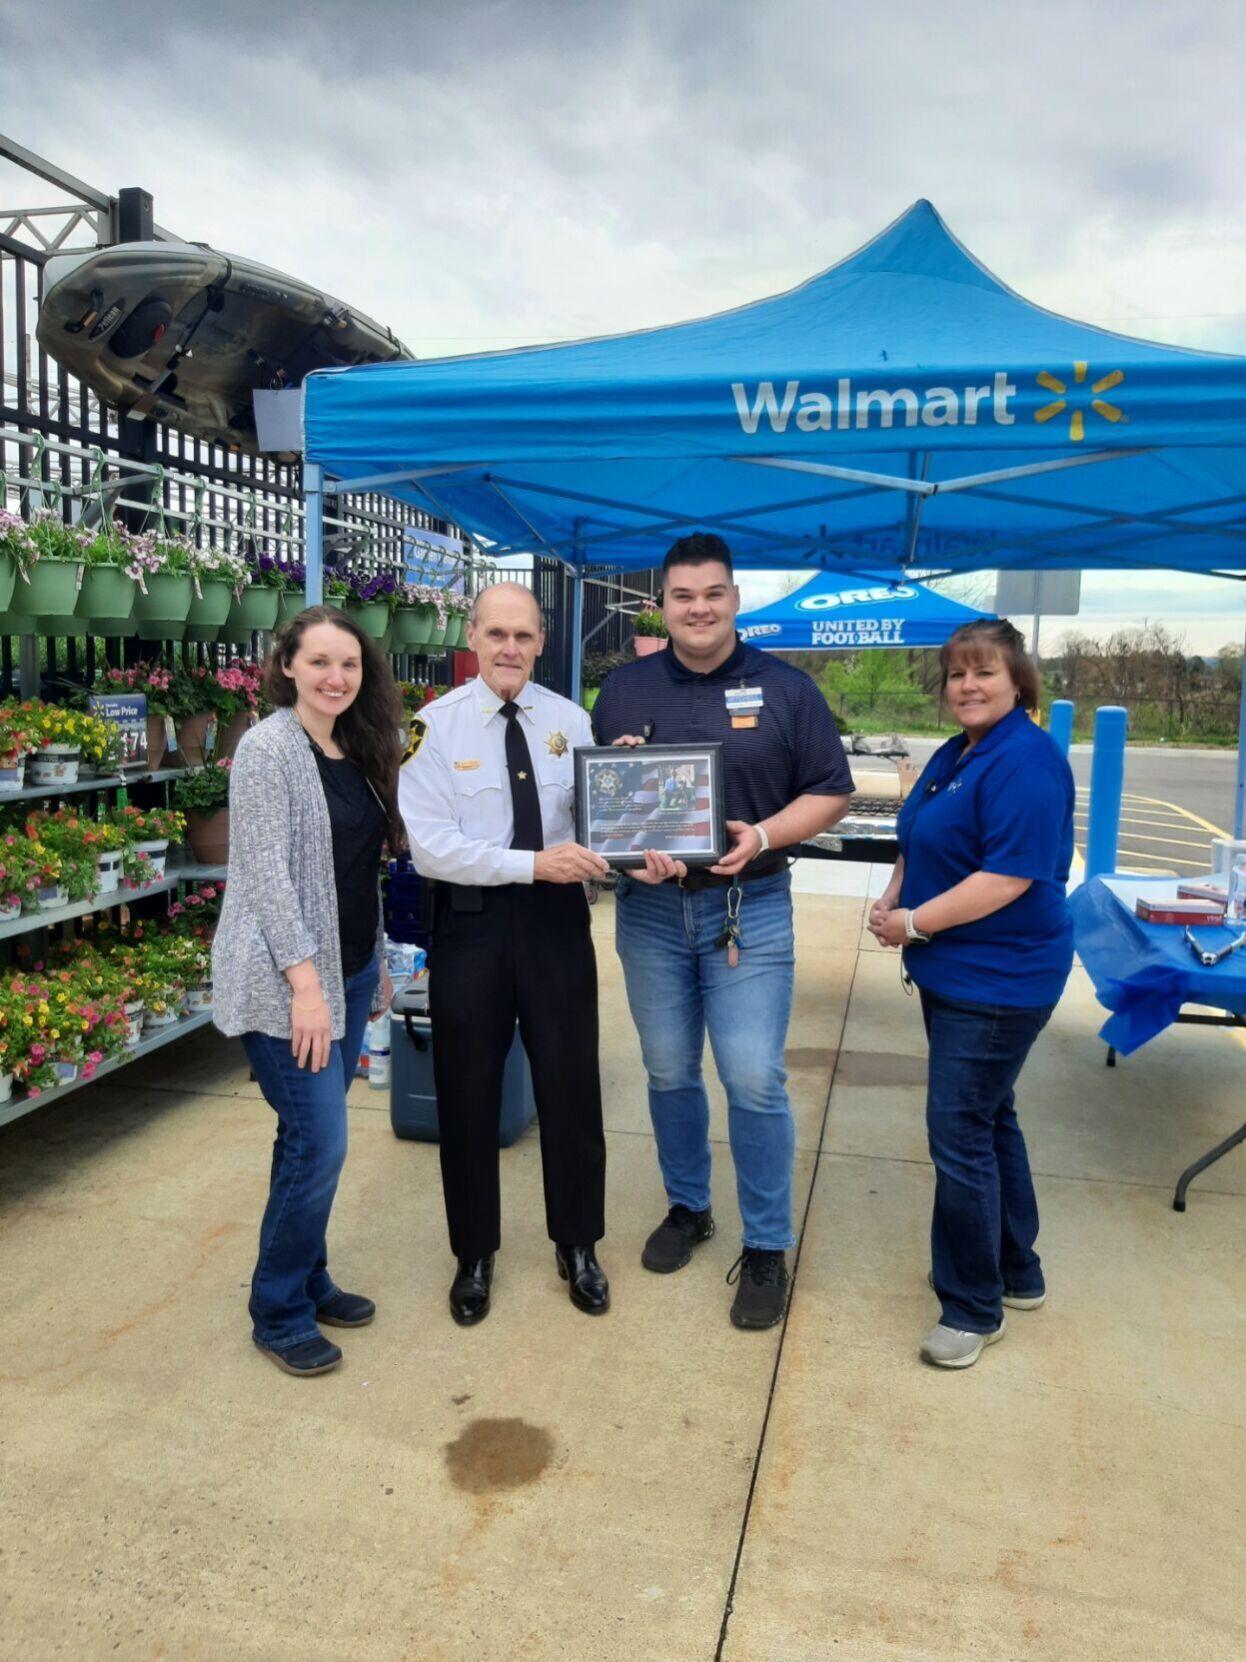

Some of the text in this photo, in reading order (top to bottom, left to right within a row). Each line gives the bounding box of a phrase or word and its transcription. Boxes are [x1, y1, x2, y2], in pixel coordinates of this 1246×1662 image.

[731, 372, 1016, 434] Walmart
[799, 586, 916, 610] OREO
[812, 619, 905, 632] UNITED BY
[812, 631, 905, 645] FOOTBALL
[106, 706, 138, 717] Low Price
